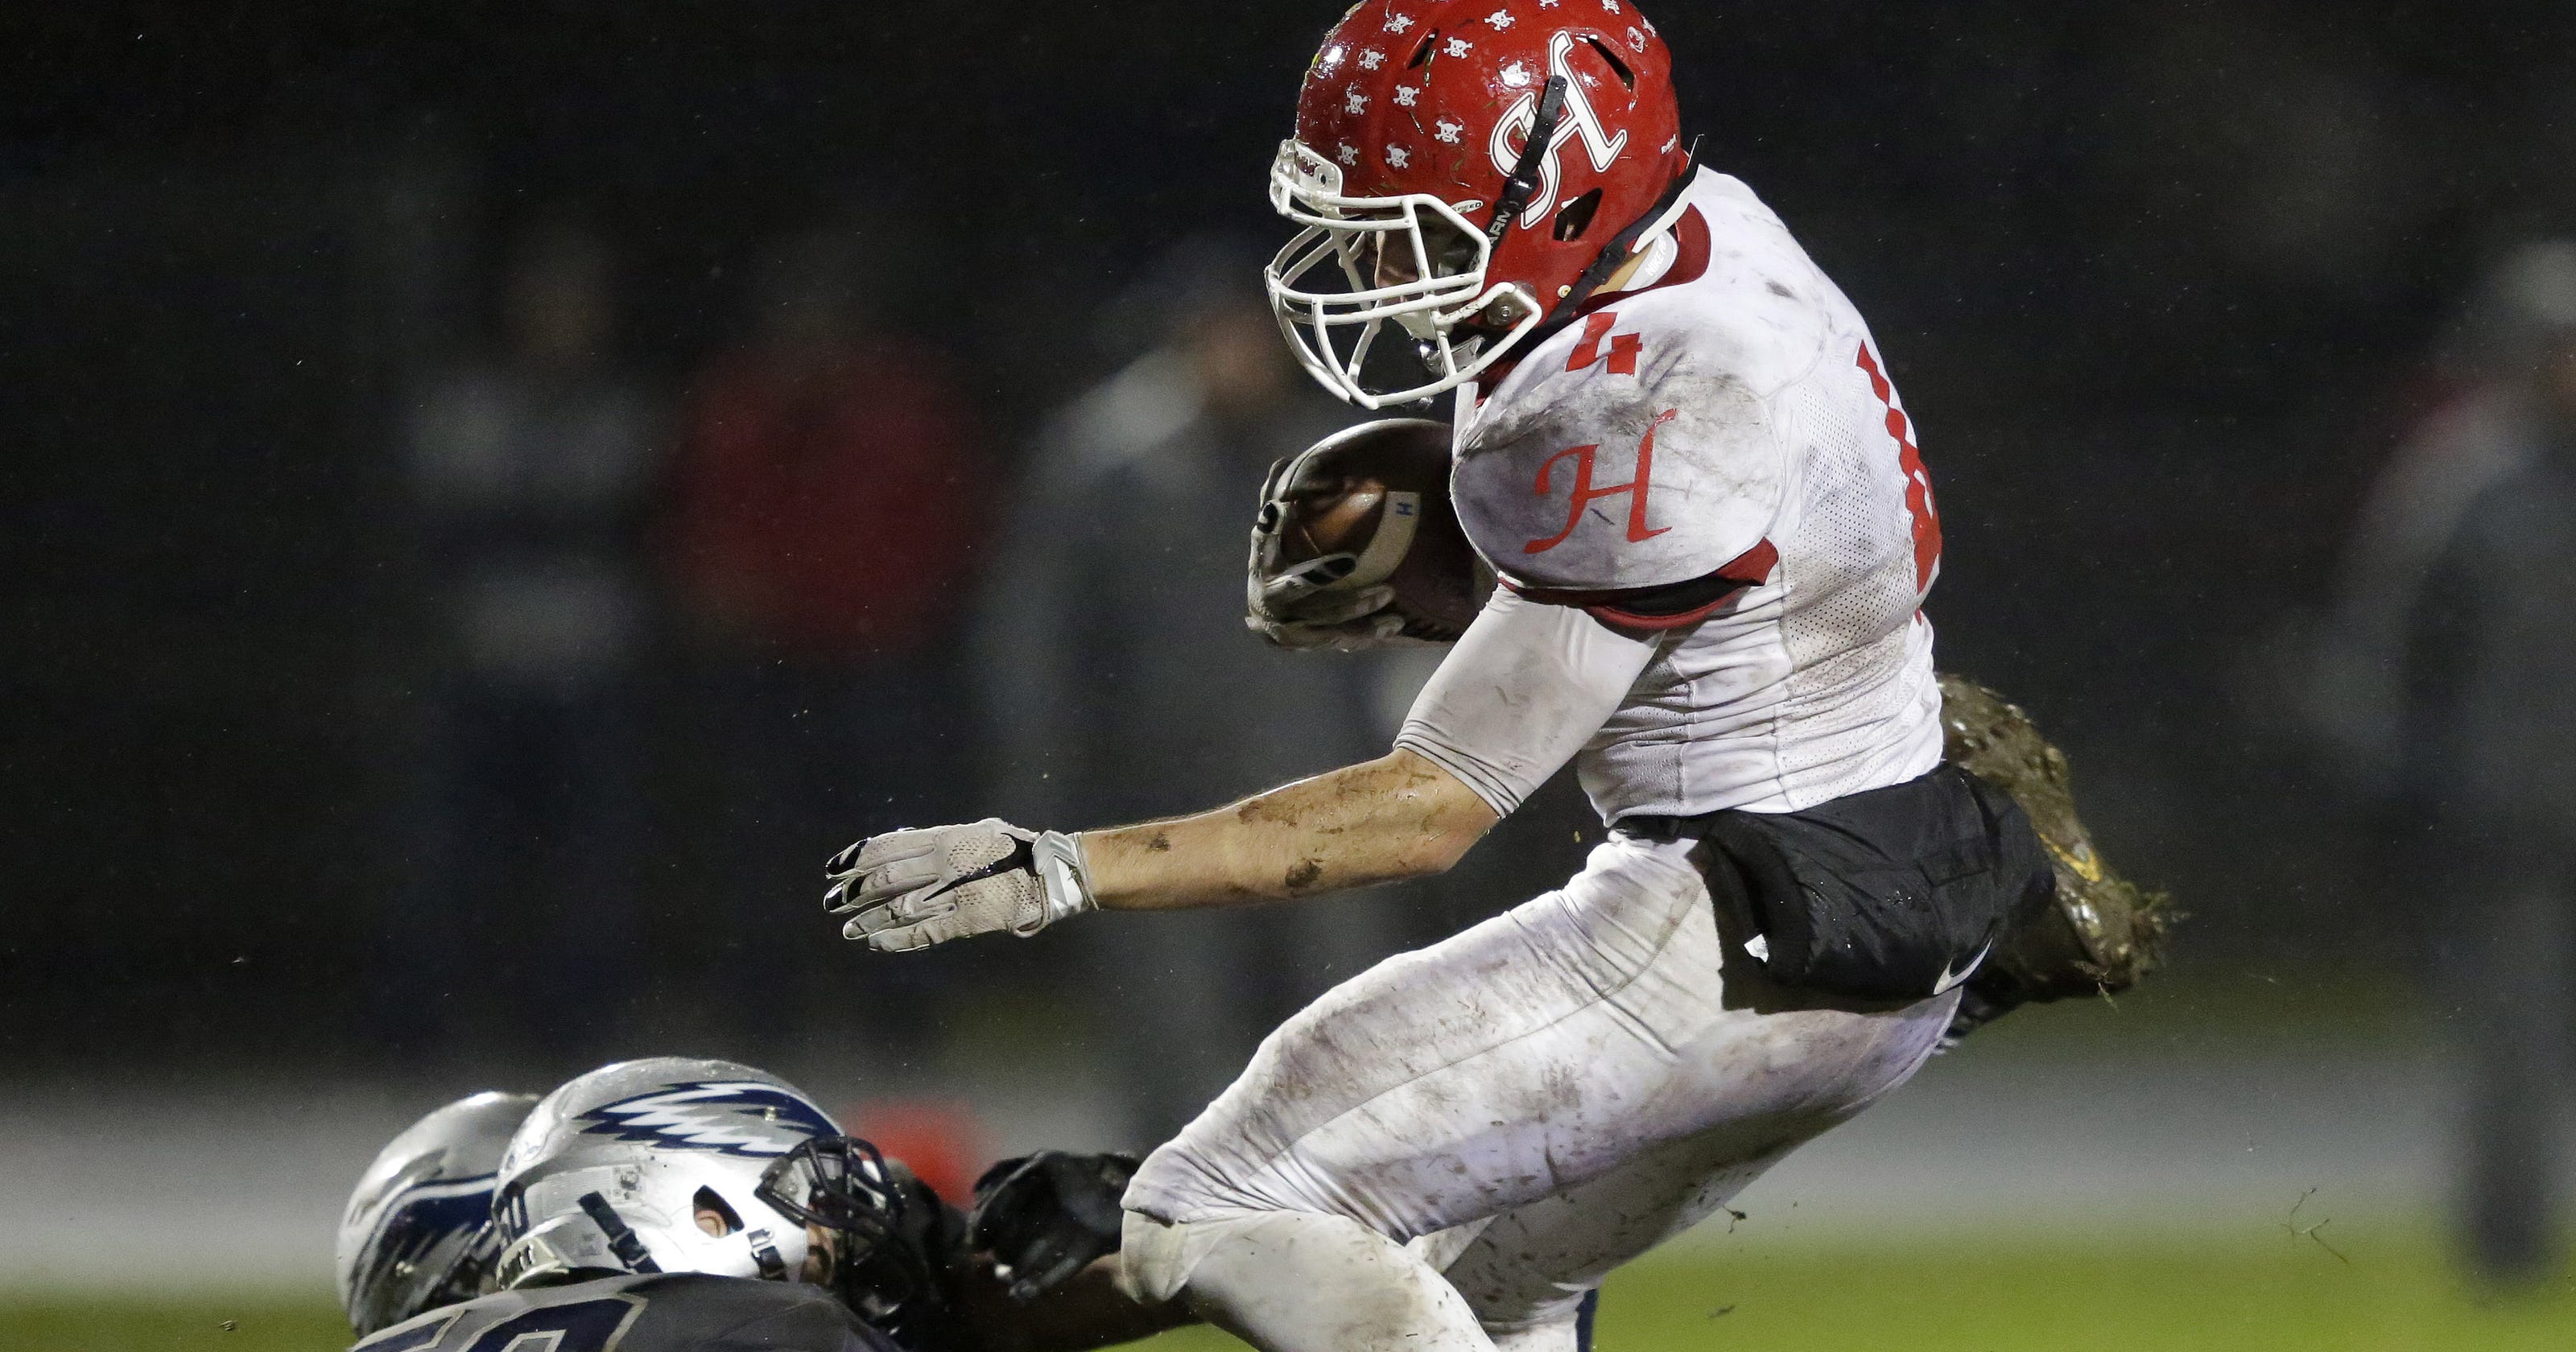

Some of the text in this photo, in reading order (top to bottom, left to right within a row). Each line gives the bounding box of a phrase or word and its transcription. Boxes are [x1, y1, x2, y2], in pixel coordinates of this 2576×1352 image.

[1489, 30, 1627, 229] H
[1566, 311, 1643, 374] 4
[1523, 408, 1677, 554] H
